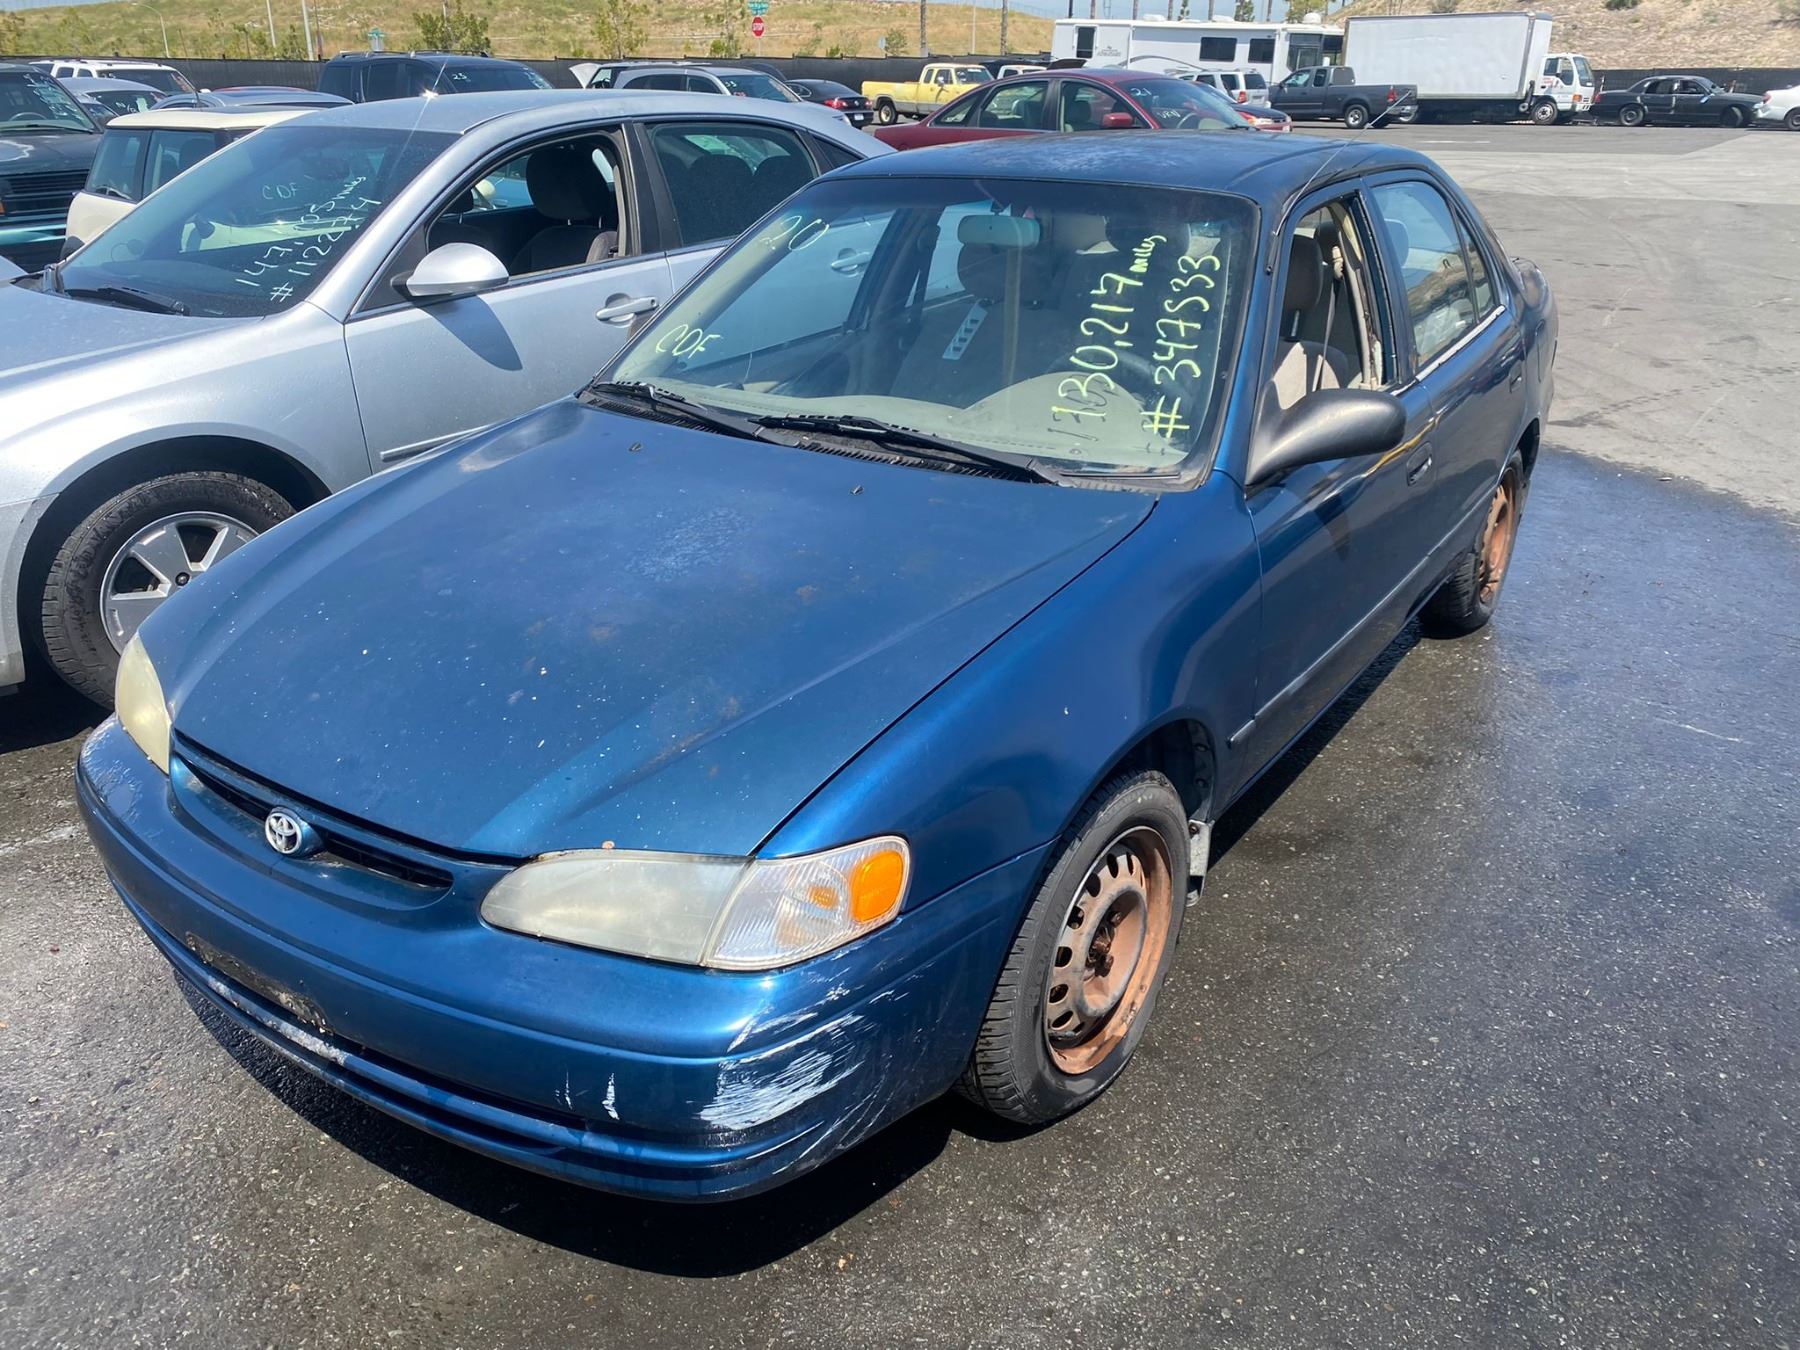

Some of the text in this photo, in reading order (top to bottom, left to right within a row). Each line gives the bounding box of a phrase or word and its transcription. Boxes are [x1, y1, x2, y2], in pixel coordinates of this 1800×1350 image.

[262, 182, 298, 200] CDF
[655, 324, 724, 360] CDF
[1051, 273, 1144, 417] 130,217
[1140, 255, 1221, 439] #347533
